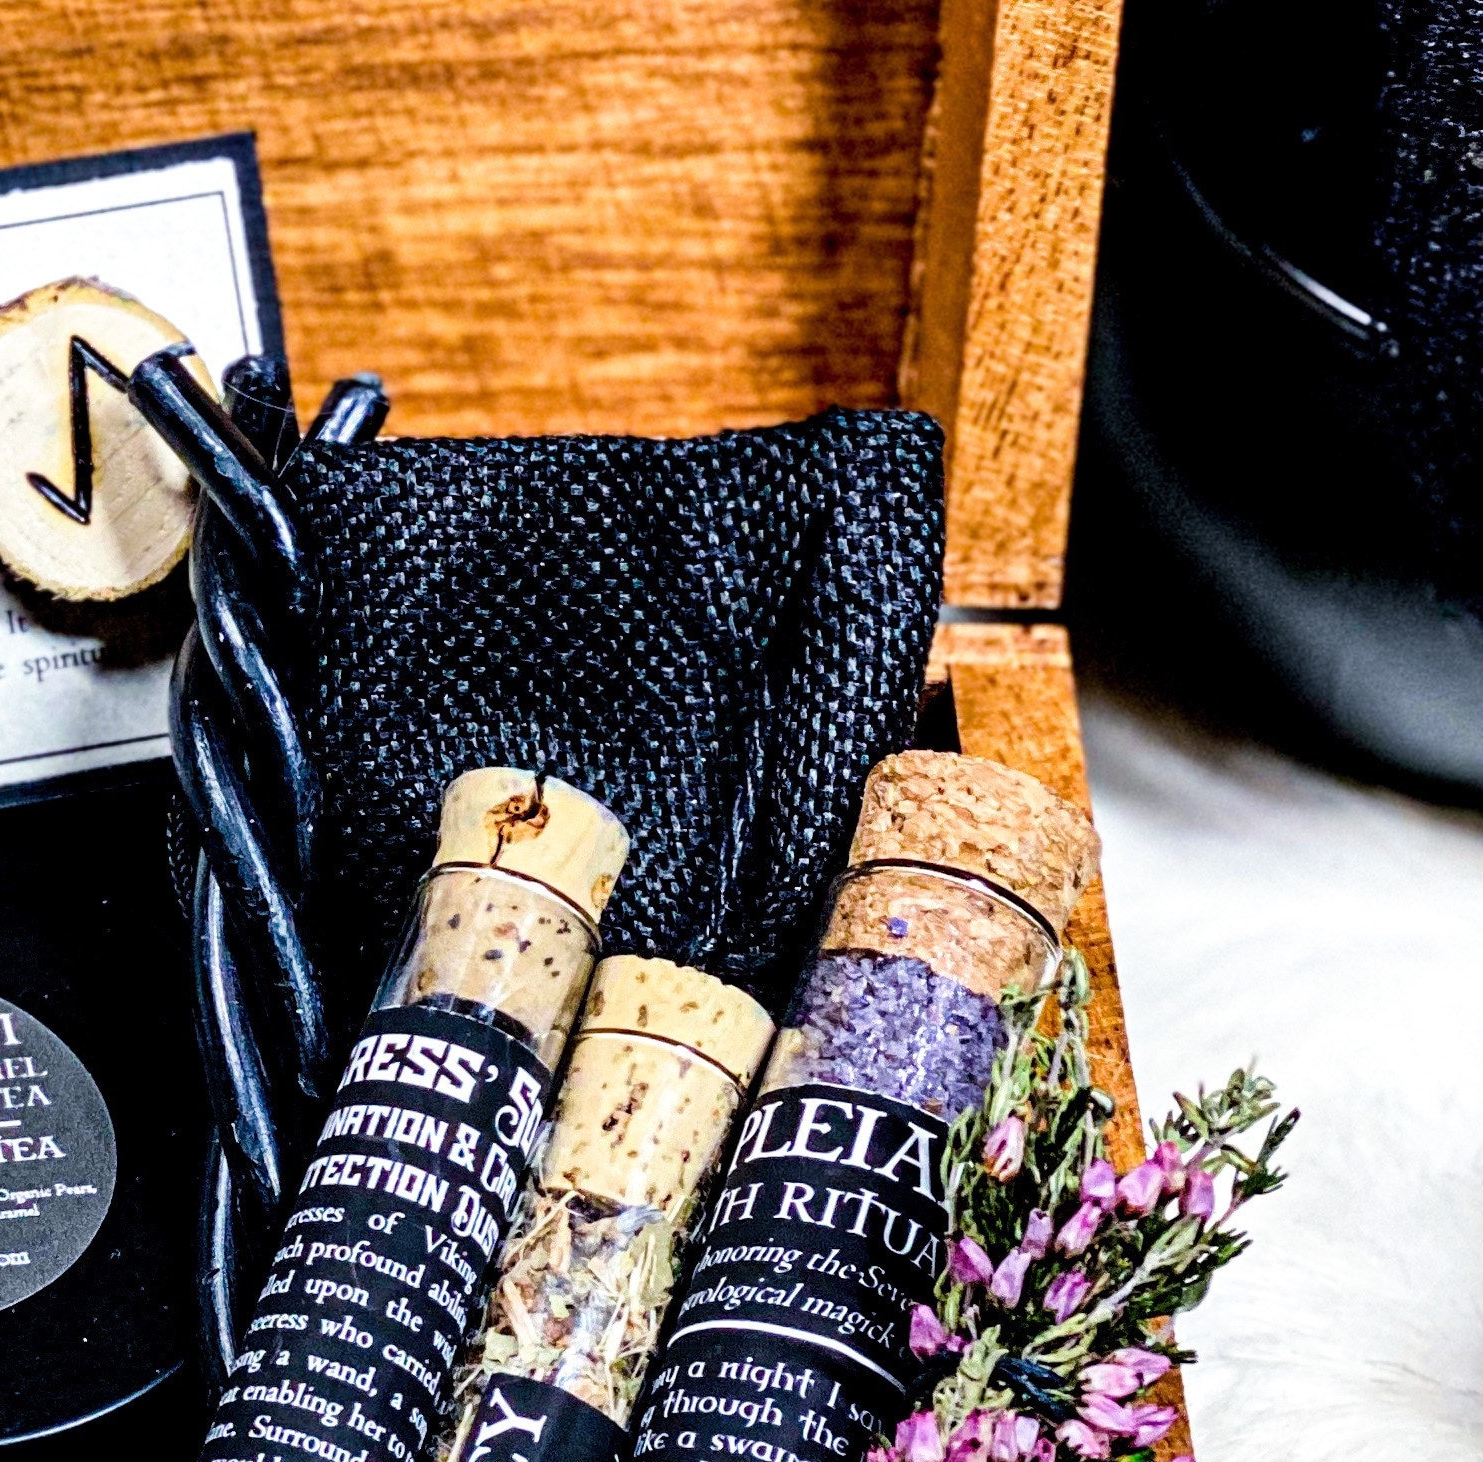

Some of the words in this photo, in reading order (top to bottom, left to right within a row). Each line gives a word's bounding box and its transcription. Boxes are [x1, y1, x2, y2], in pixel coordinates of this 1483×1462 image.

[305, 1240, 426, 1289] profound
[424, 1224, 478, 1295] Viking
[304, 1278, 370, 1307] upon
[385, 1297, 424, 1333] the
[320, 1315, 374, 1349] who
[718, 1356, 816, 1400] night
[242, 1379, 345, 1428] enabling
[346, 1402, 387, 1442] her
[662, 1388, 783, 1428] through
